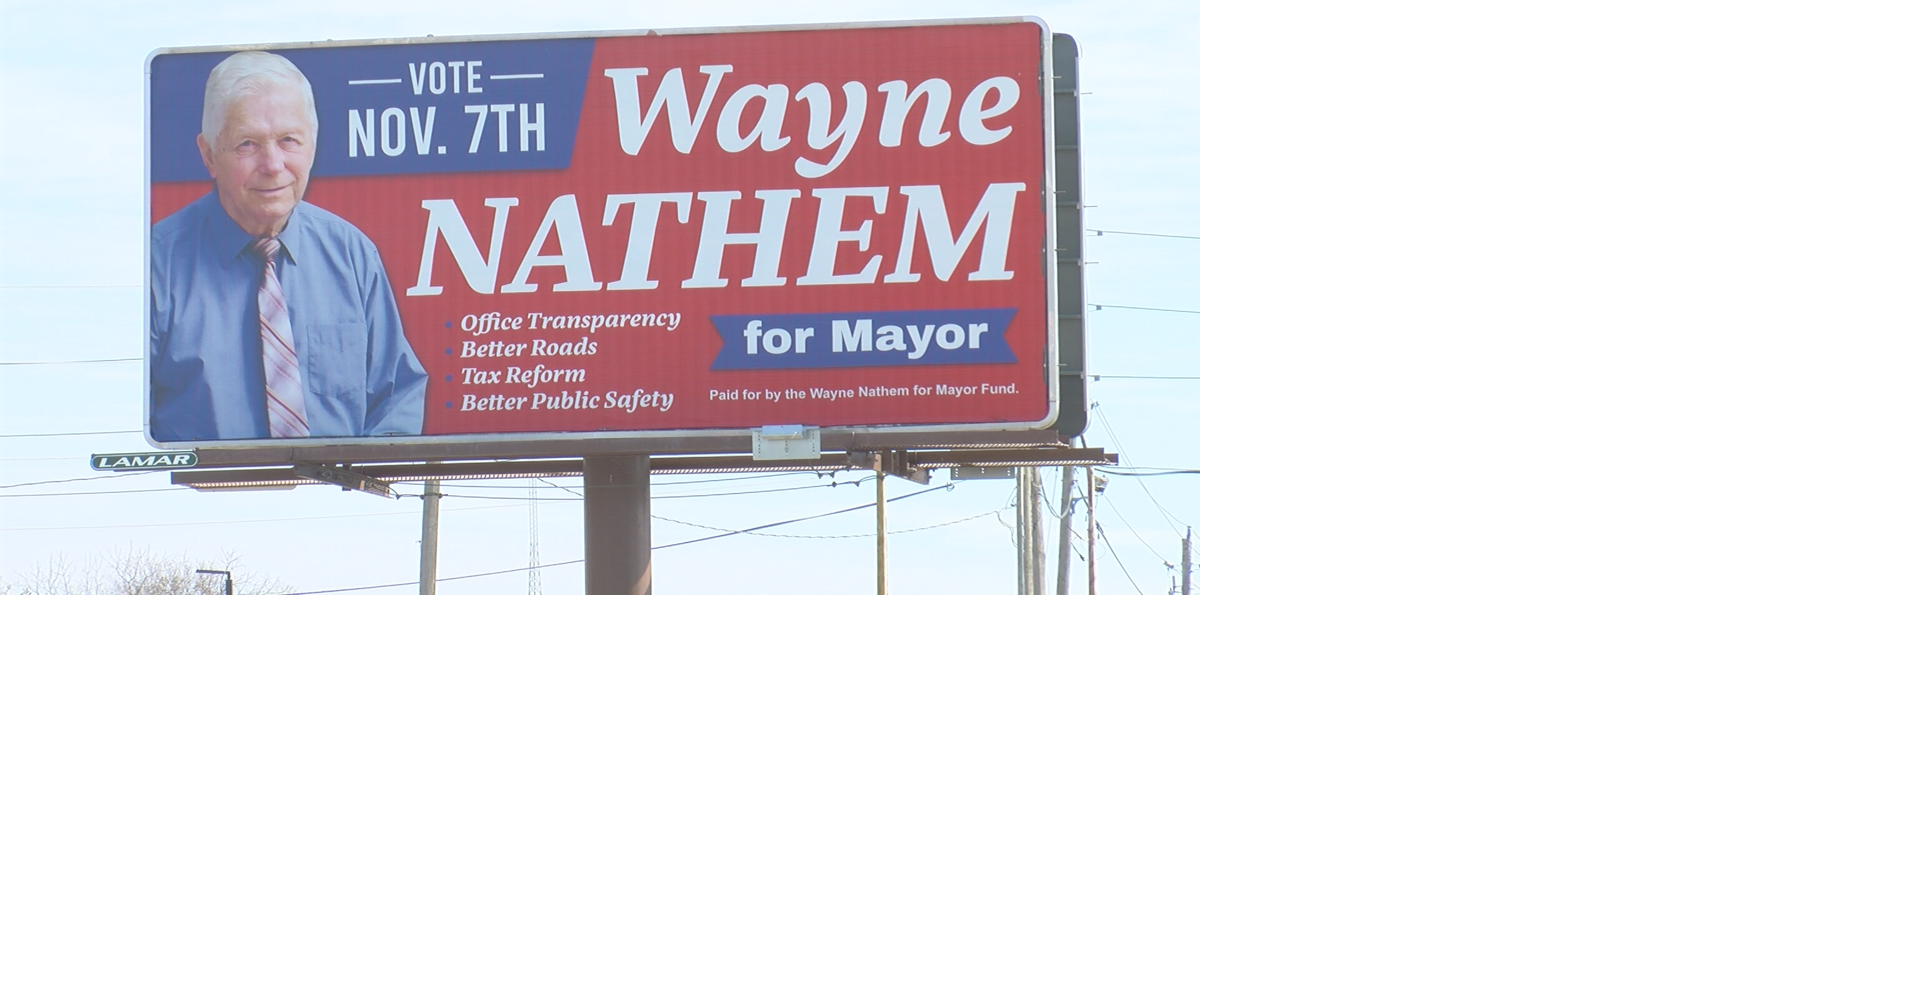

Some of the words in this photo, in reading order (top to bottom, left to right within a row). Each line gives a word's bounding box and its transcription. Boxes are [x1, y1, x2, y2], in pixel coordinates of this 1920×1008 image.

[408, 60, 484, 96] VOTE
[348, 106, 447, 158] NOV.
[464, 102, 546, 154] 7TH
[603, 63, 1021, 179] Wayne
[405, 181, 1027, 297] NATHEM
[460, 311, 524, 336] Office
[526, 311, 682, 333] Transparency
[459, 339, 527, 359] Better
[529, 335, 599, 358] Roads
[743, 319, 815, 355] for
[831, 318, 989, 360] Mayor
[461, 366, 502, 386] Tax
[504, 363, 586, 388] Reform
[459, 393, 527, 413] Better
[530, 389, 601, 411] Public
[603, 388, 675, 414] Safety
[709, 388, 739, 402] Paid
[741, 388, 762, 402] for
[765, 388, 782, 404] by
[784, 387, 807, 401] the
[809, 387, 855, 403] Wayne
[858, 385, 910, 399] Nathem
[912, 384, 933, 398] for
[935, 384, 978, 400] Mayor
[980, 382, 1020, 396] Fund.
[98, 454, 190, 468] LAMAR
